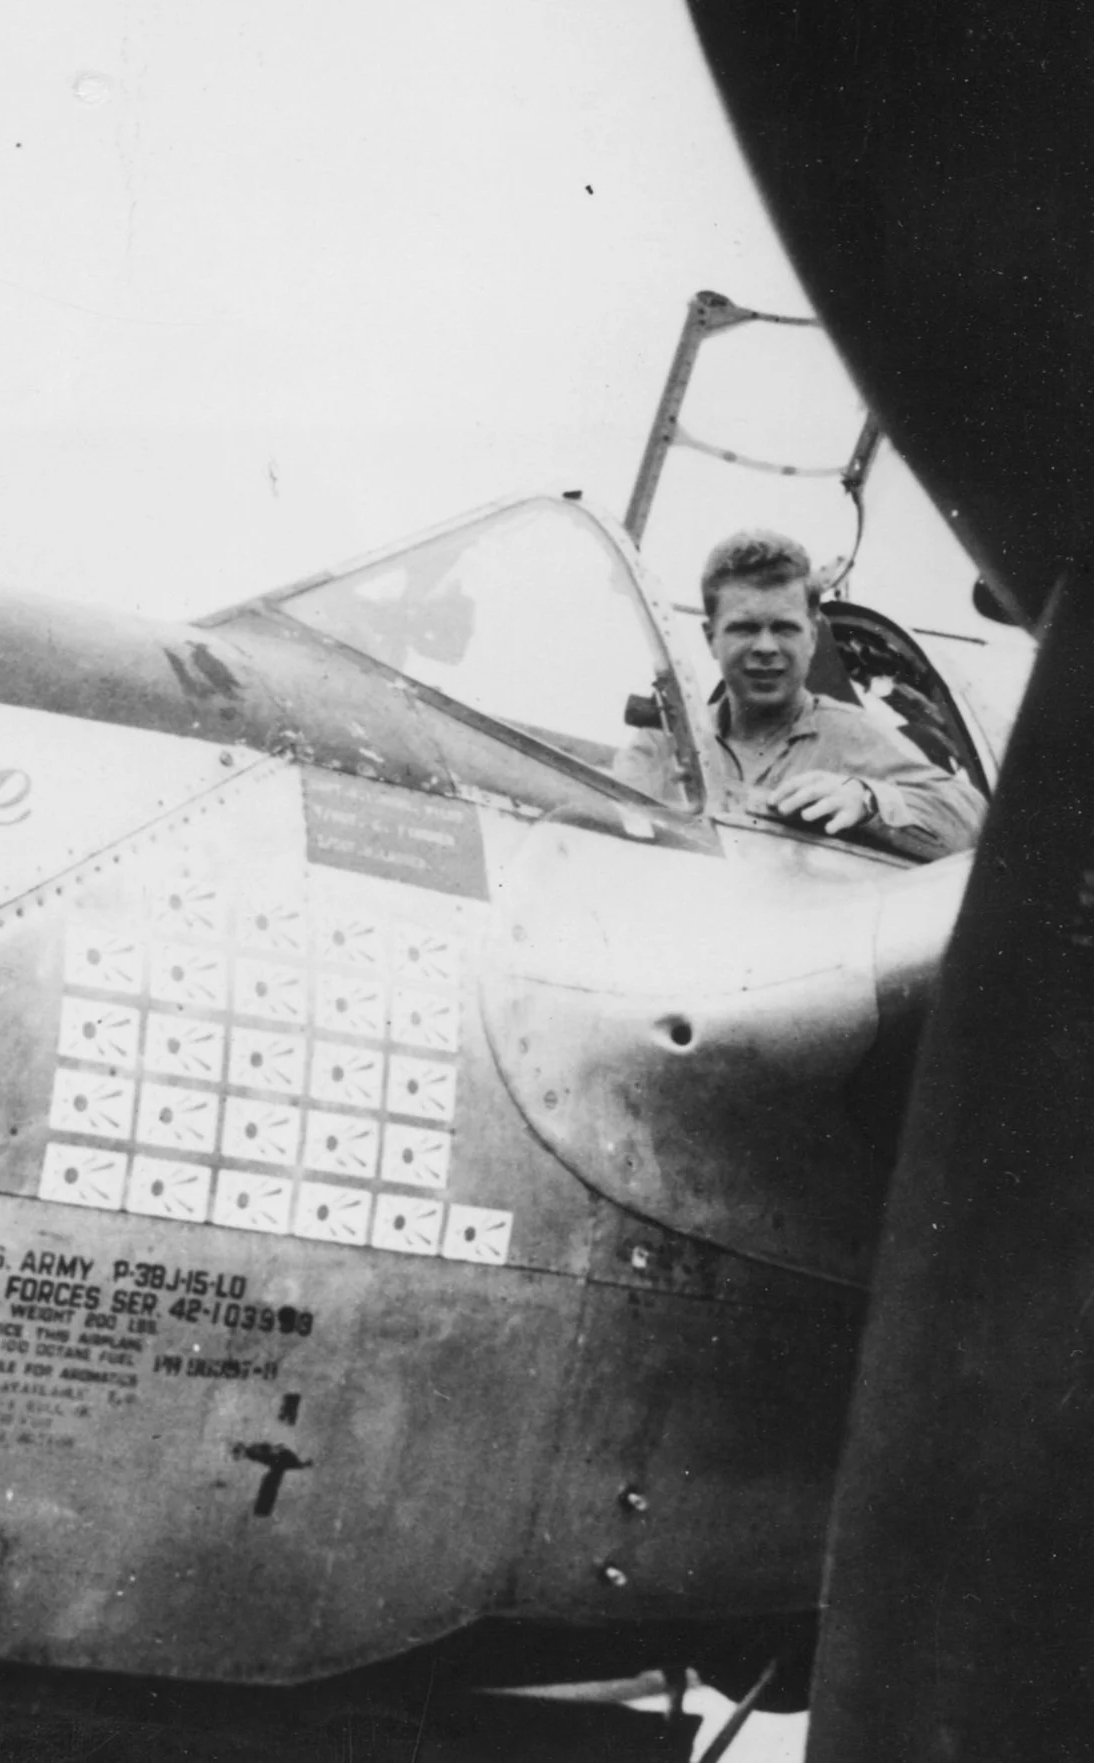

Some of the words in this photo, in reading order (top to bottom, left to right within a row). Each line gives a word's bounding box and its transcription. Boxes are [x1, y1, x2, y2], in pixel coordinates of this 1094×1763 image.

[20, 1249, 95, 1281] ARMY
[112, 1260, 247, 1300] P-38J-15-LO
[5, 1275, 102, 1310] FORCES
[110, 1289, 162, 1319] SER.
[11, 1302, 76, 1324] WEIGHT
